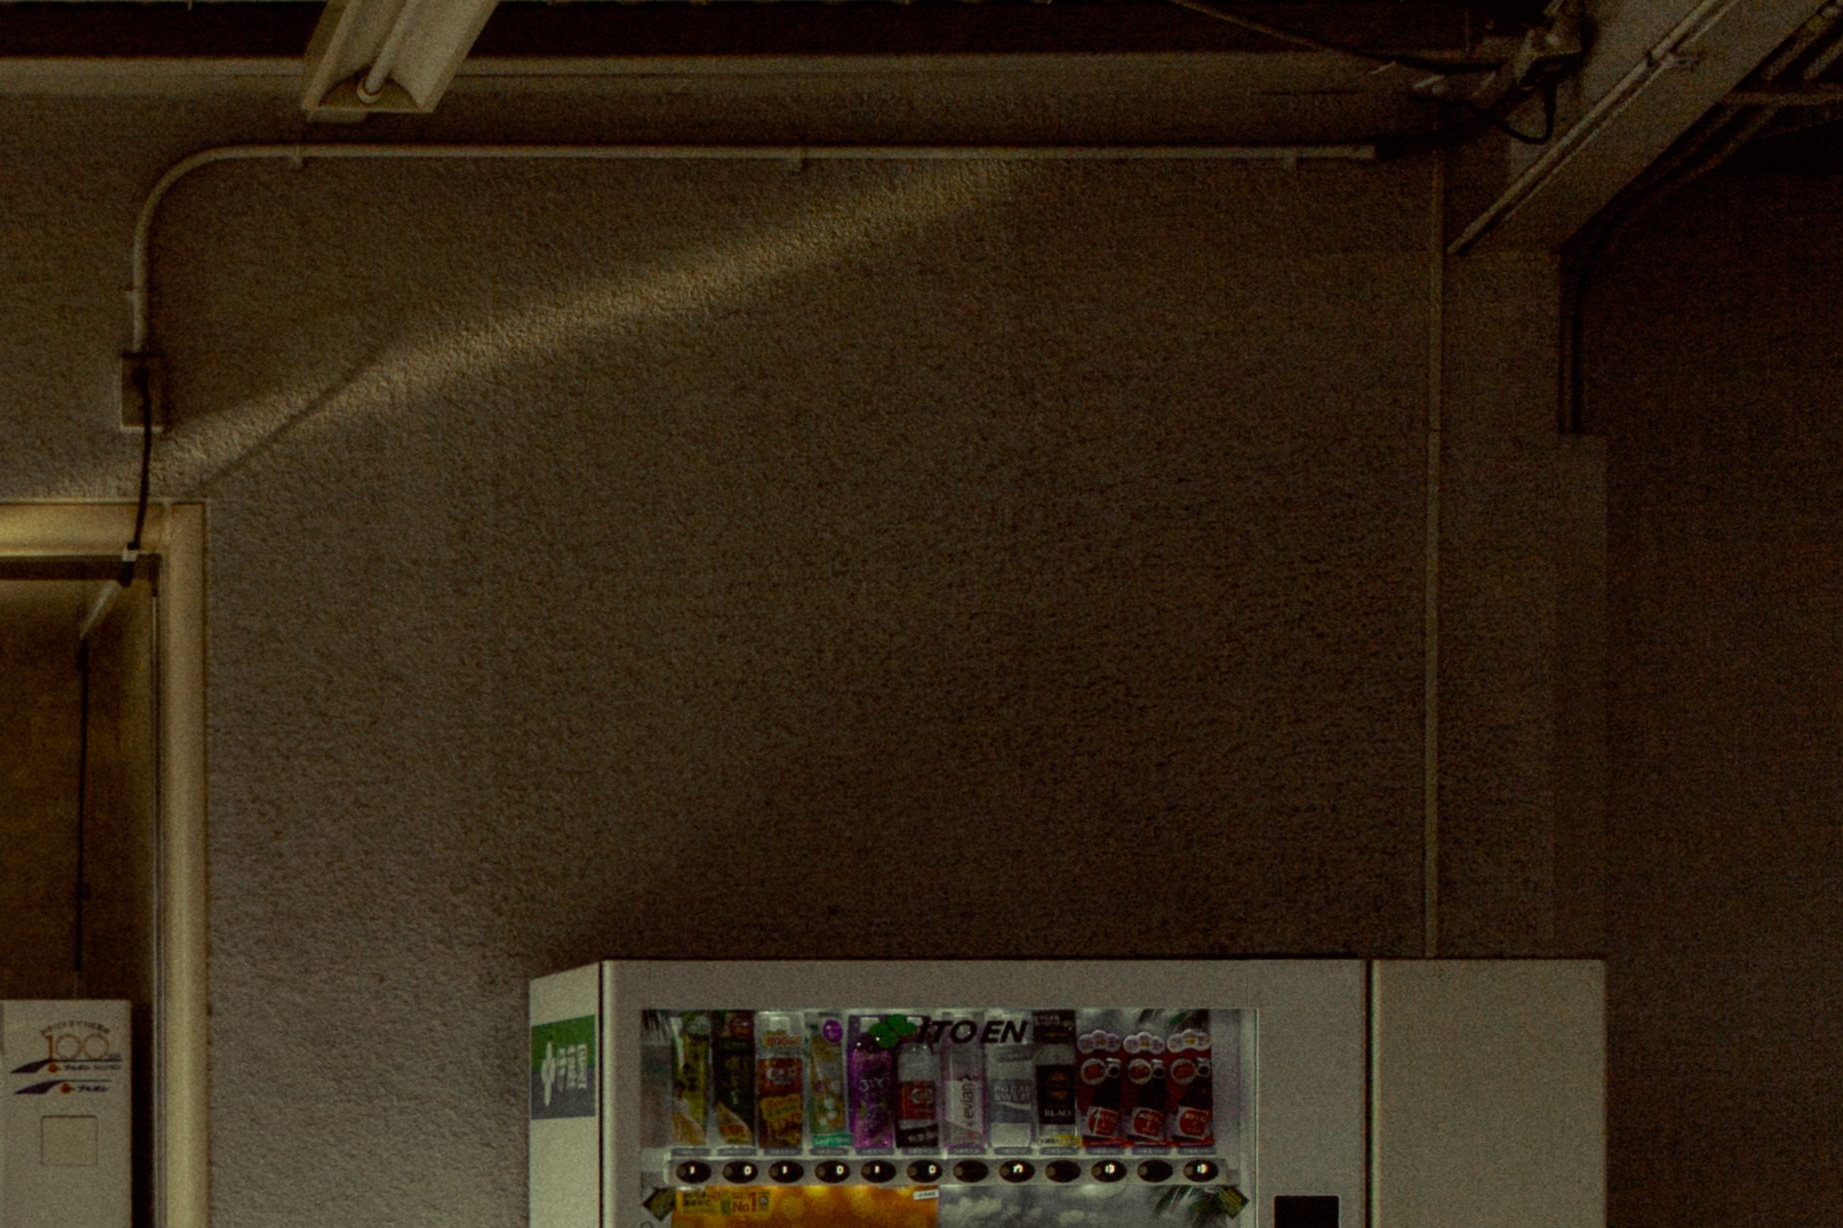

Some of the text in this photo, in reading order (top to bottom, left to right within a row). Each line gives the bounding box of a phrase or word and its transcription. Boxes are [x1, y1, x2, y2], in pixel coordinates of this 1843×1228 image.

[918, 1021, 1027, 1043] ITO EN
[959, 1083, 976, 1120] evian
